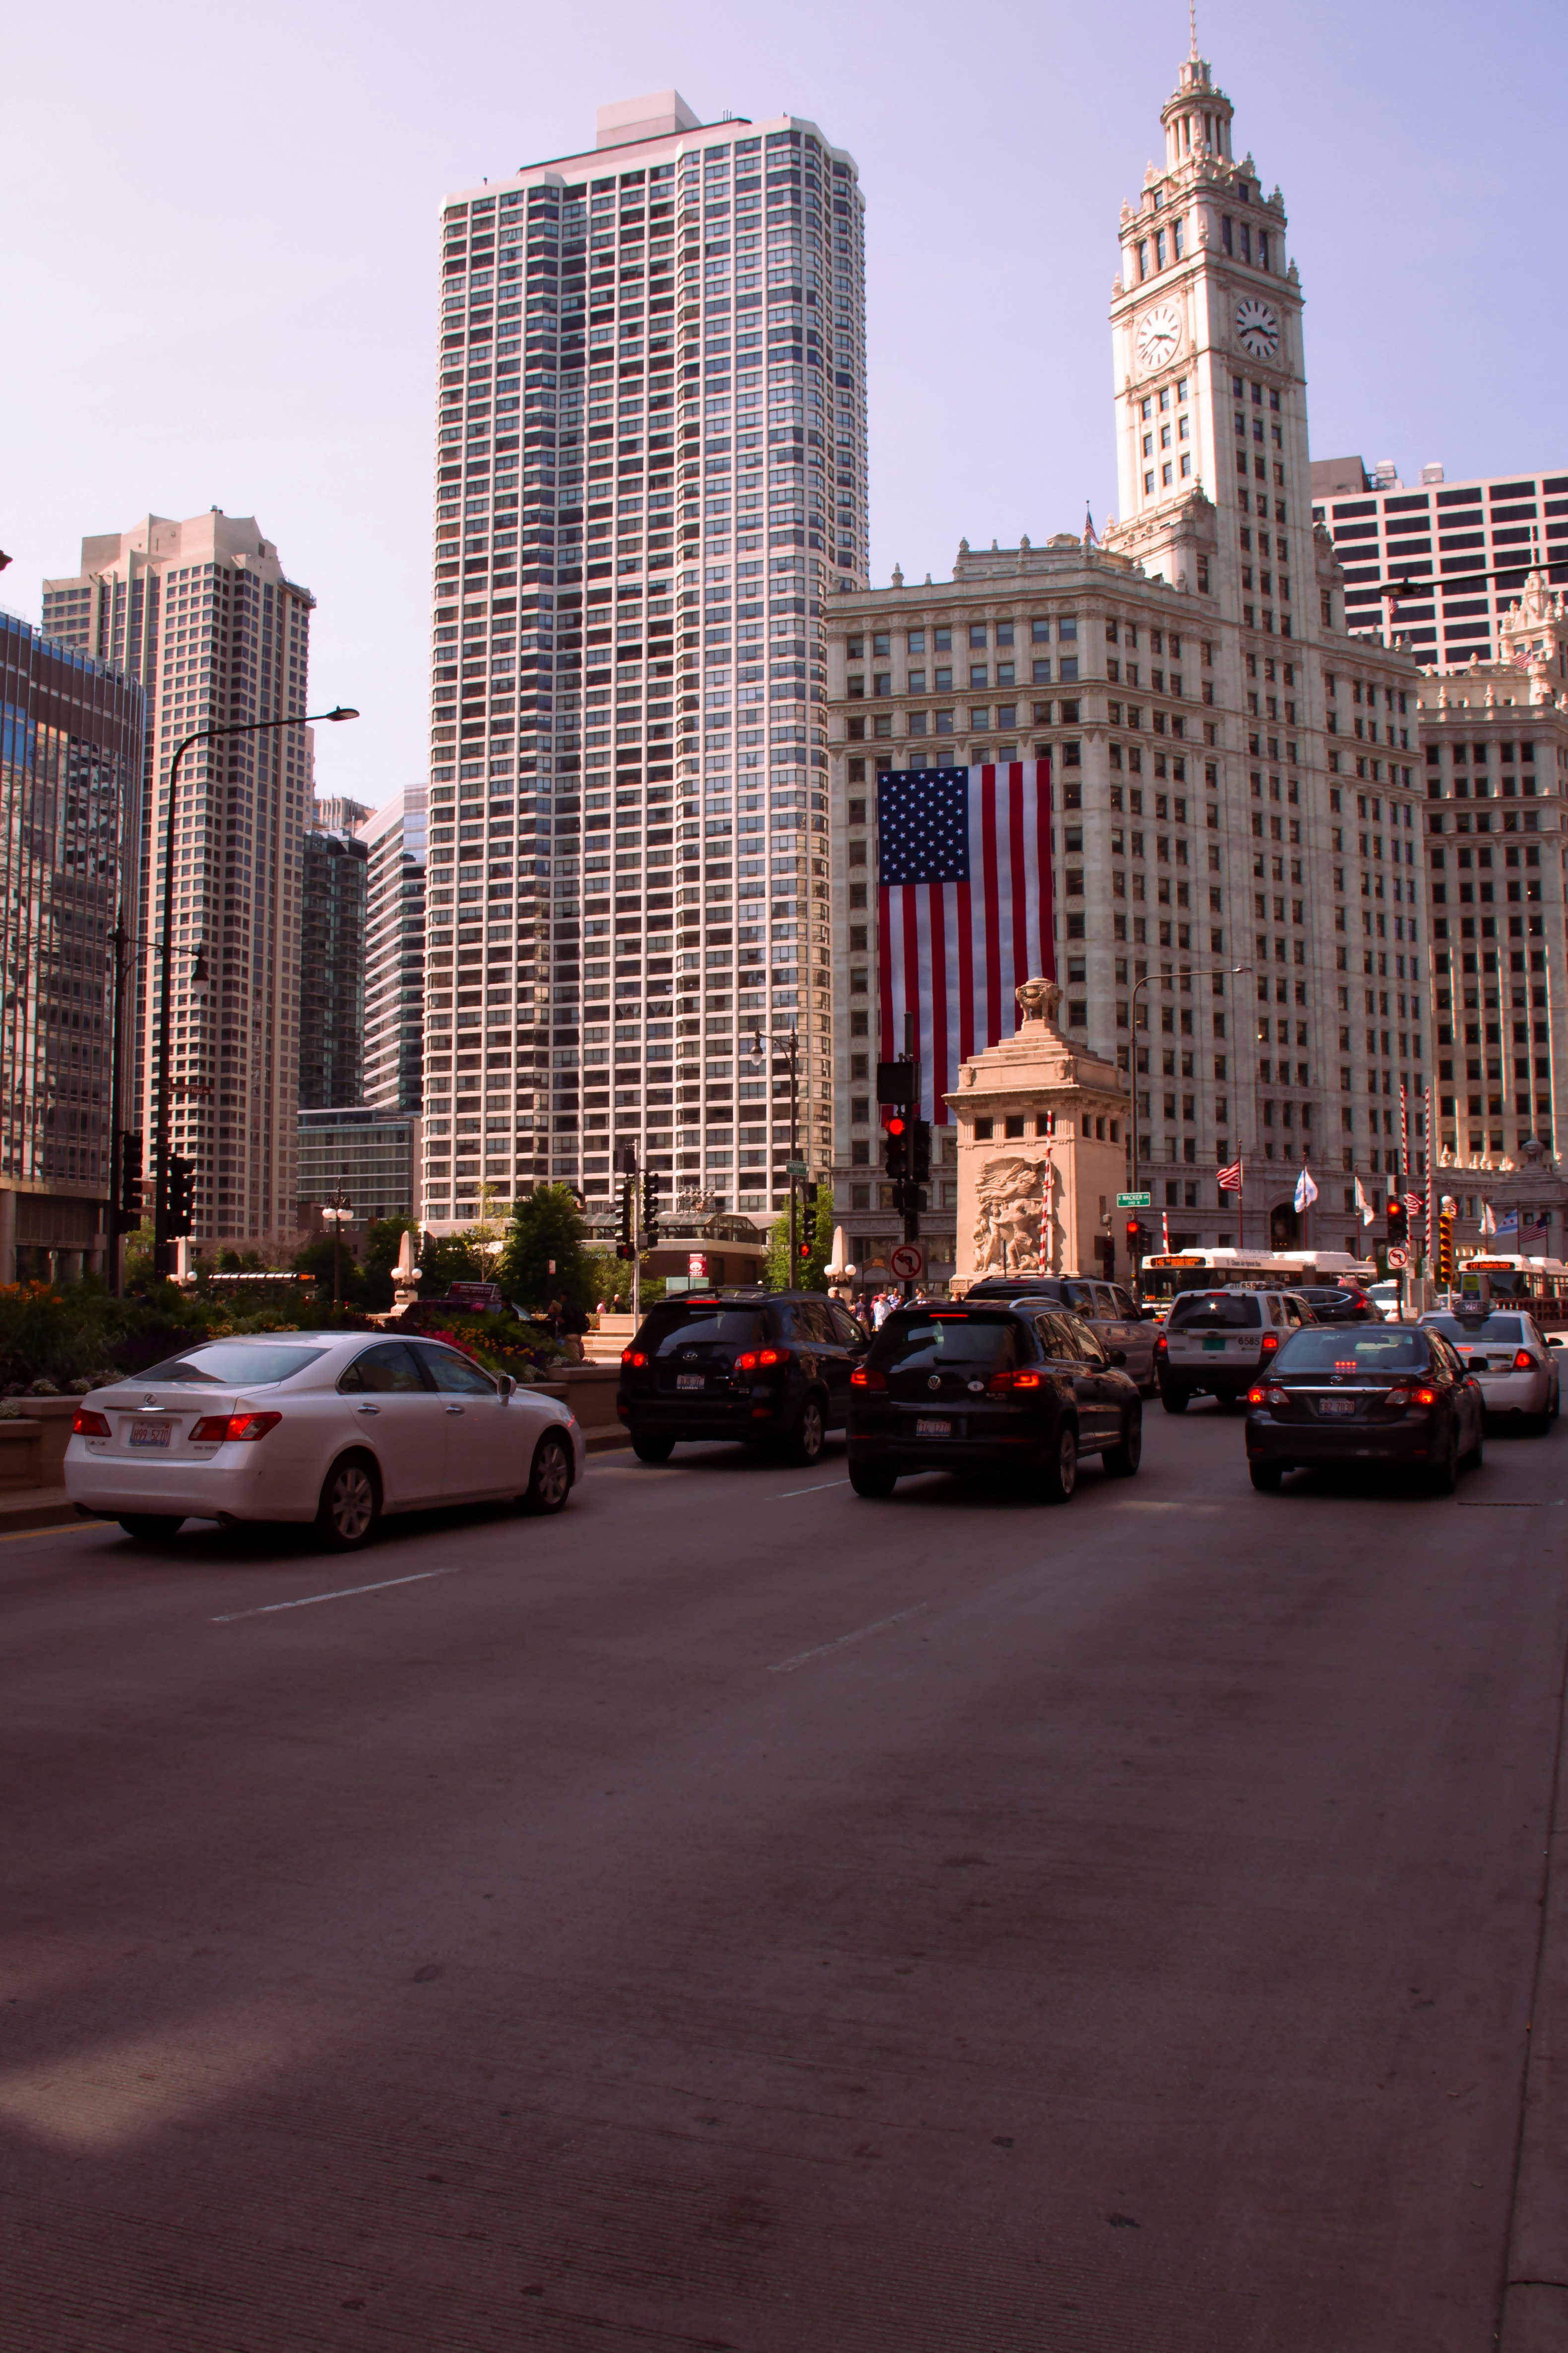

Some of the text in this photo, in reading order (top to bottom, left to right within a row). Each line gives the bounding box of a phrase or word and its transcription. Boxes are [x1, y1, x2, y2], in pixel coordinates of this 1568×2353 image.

[1238, 1337, 1260, 1345] 6585
[1336, 1402, 1354, 1411] 7030
[134, 1429, 169, 1441] H99 5270
